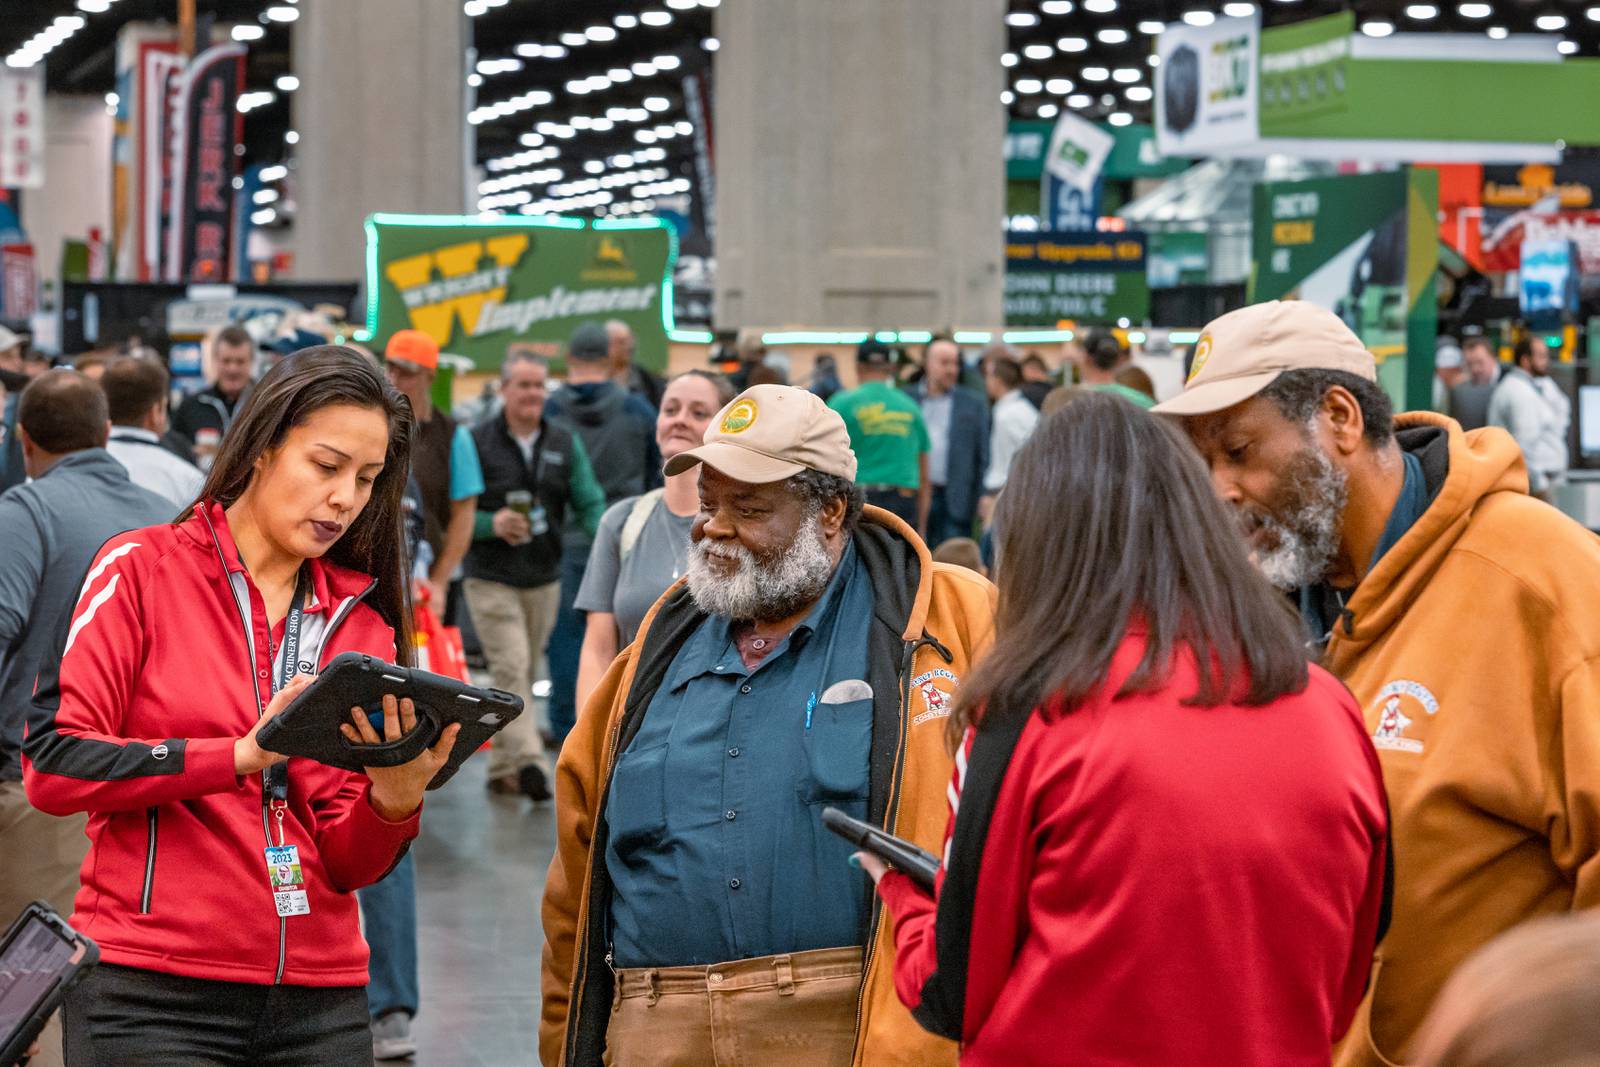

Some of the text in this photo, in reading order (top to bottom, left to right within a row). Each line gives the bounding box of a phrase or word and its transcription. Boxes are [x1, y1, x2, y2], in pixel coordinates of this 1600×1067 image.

[1004, 272, 1116, 294] OHN DEERE
[473, 282, 657, 337] Implement
[289, 608, 300, 634] SHOW
[271, 853, 293, 864] 2023
